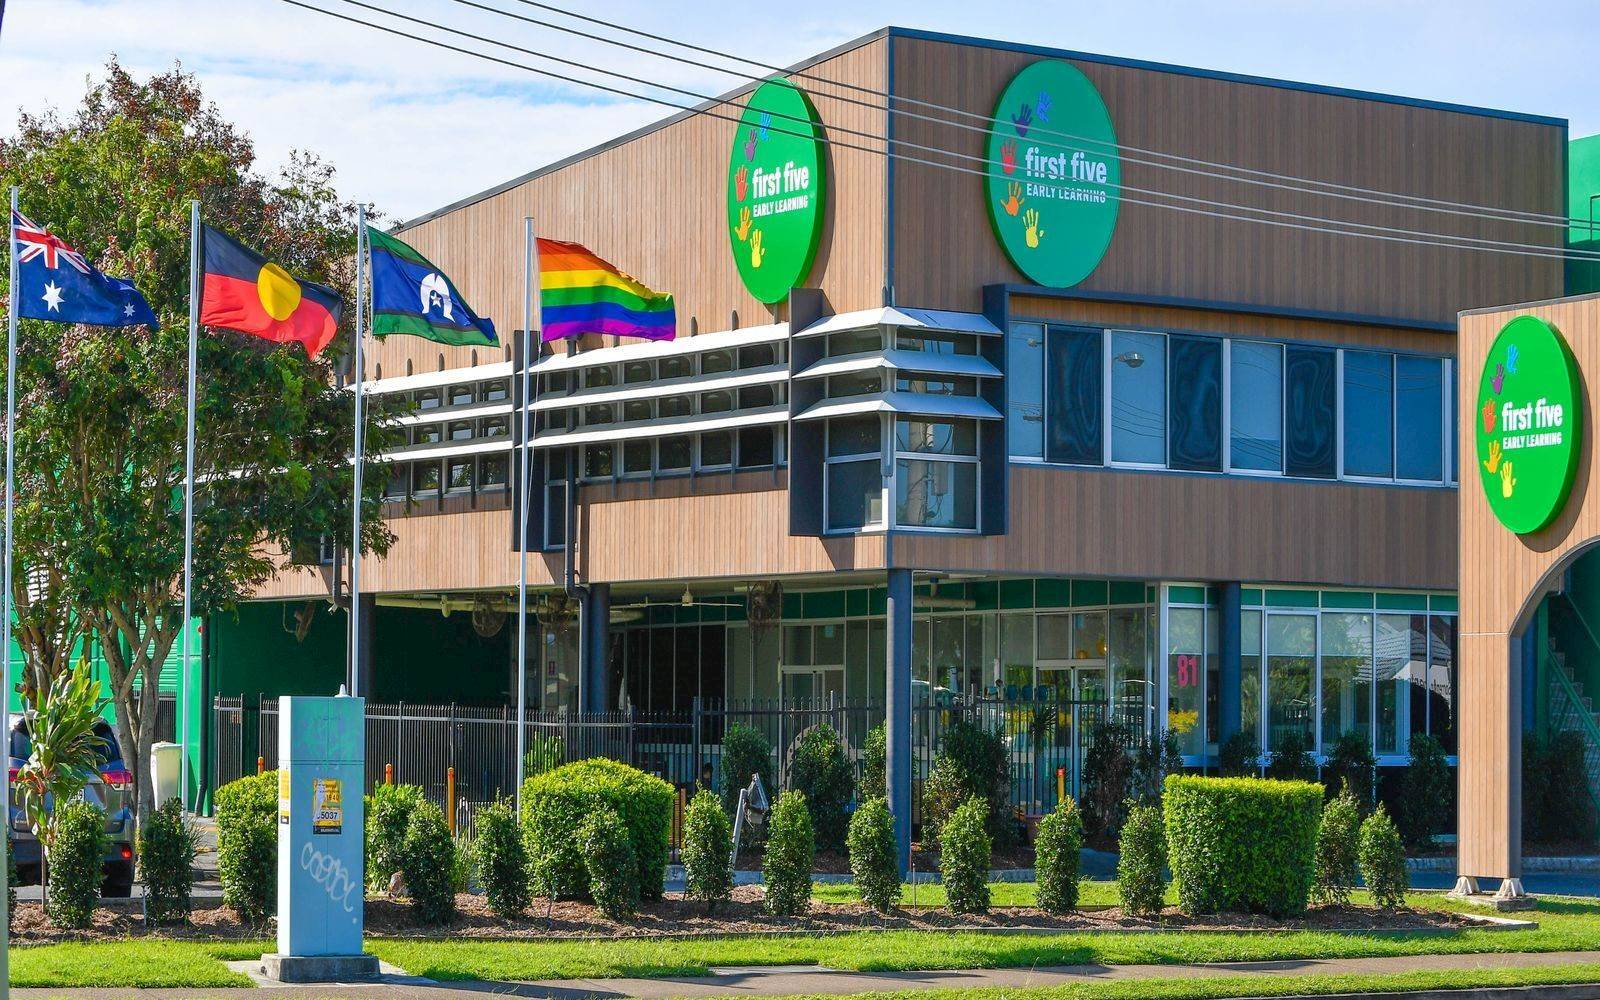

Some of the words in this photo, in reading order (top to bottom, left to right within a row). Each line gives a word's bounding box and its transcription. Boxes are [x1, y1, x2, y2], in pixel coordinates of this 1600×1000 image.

[752, 167, 781, 199] first
[784, 161, 809, 193] five
[1025, 147, 1066, 180] first
[1071, 152, 1107, 184] five
[753, 201, 775, 217] EARLY
[775, 195, 808, 213] LEARNING
[1026, 183, 1056, 198] EARLY
[1058, 187, 1106, 203] LEARNING
[1502, 401, 1532, 431] first
[1535, 397, 1563, 428] five
[1503, 435, 1525, 449] EARLY
[1526, 432, 1562, 447] LEARNING
[1177, 654, 1199, 688] 81
